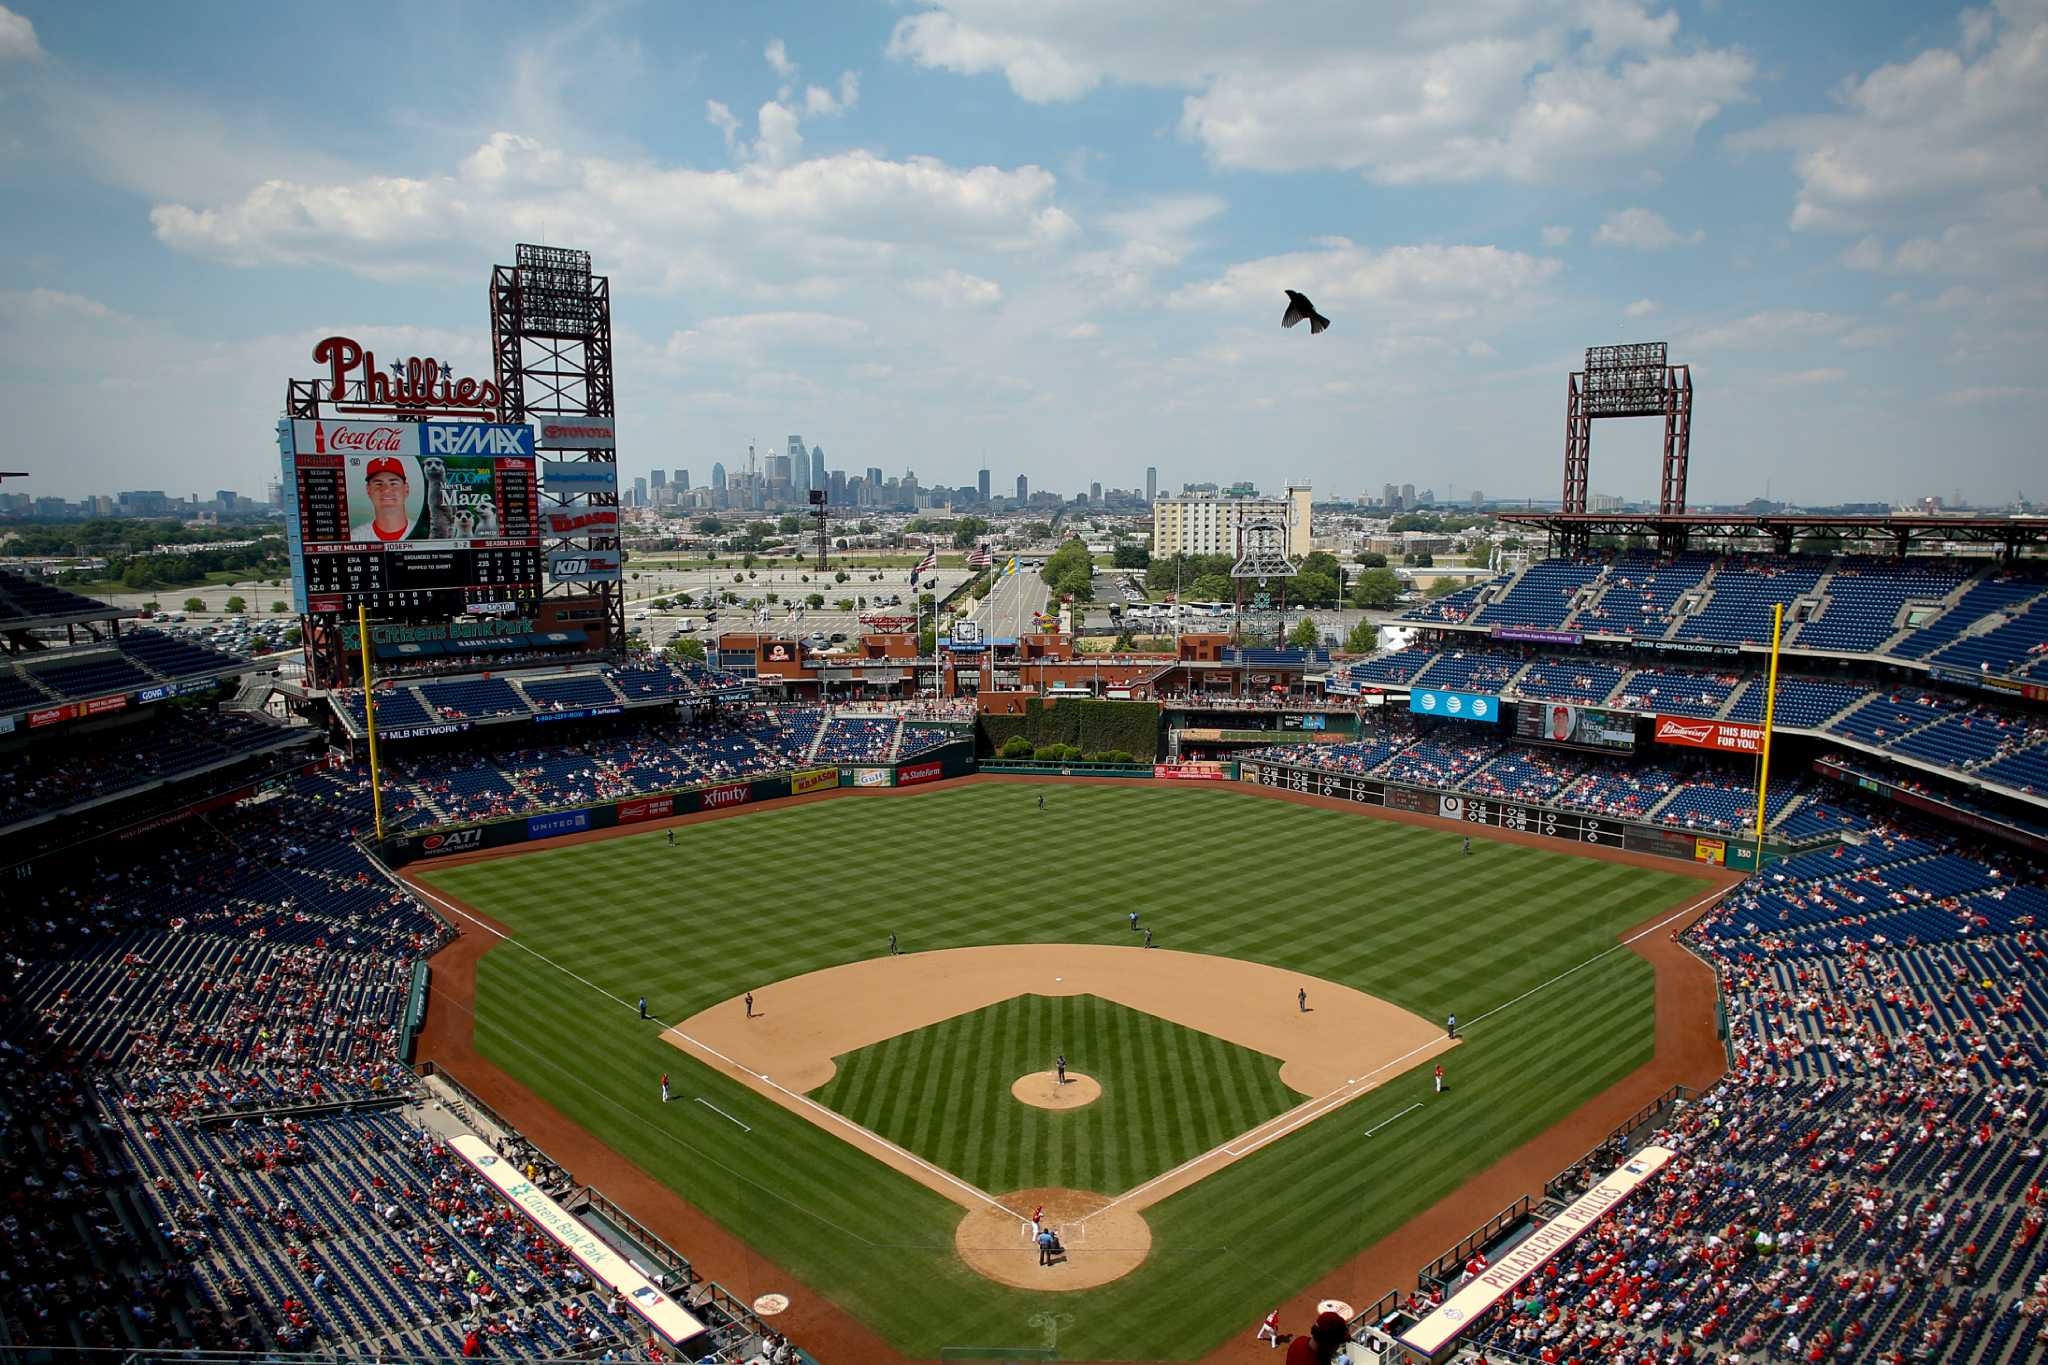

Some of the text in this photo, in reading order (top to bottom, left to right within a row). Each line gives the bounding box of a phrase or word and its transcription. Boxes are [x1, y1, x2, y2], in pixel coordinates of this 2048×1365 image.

[312, 336, 502, 408] Phillies
[330, 425, 403, 451] Coca-Cola
[428, 425, 526, 455] RE/MAX
[441, 490, 492, 506] Maze
[387, 543, 413, 551] JOSEPH
[554, 559, 588, 575] KDI
[506, 589, 536, 599] 1 2 1
[372, 617, 534, 644] Citizens Bank Park
[1655, 642, 1713, 653] CSNPHILLY.COM
[1723, 647, 1739, 655] TCN
[389, 724, 458, 740] MLB NETWORK
[1663, 723, 1708, 738] Budweiser
[1718, 725, 1767, 741] THIS BUD'S
[1717, 736, 1758, 750] FOR YOU.
[861, 771, 883, 784] Gulf
[704, 785, 748, 807] xfinity
[532, 819, 573, 832] UNITED
[443, 828, 482, 847] ATI
[524, 1196, 609, 1264] Citizens Bank Park
[1481, 1185, 1622, 1290] PHILADELPHIA PHILLIES
